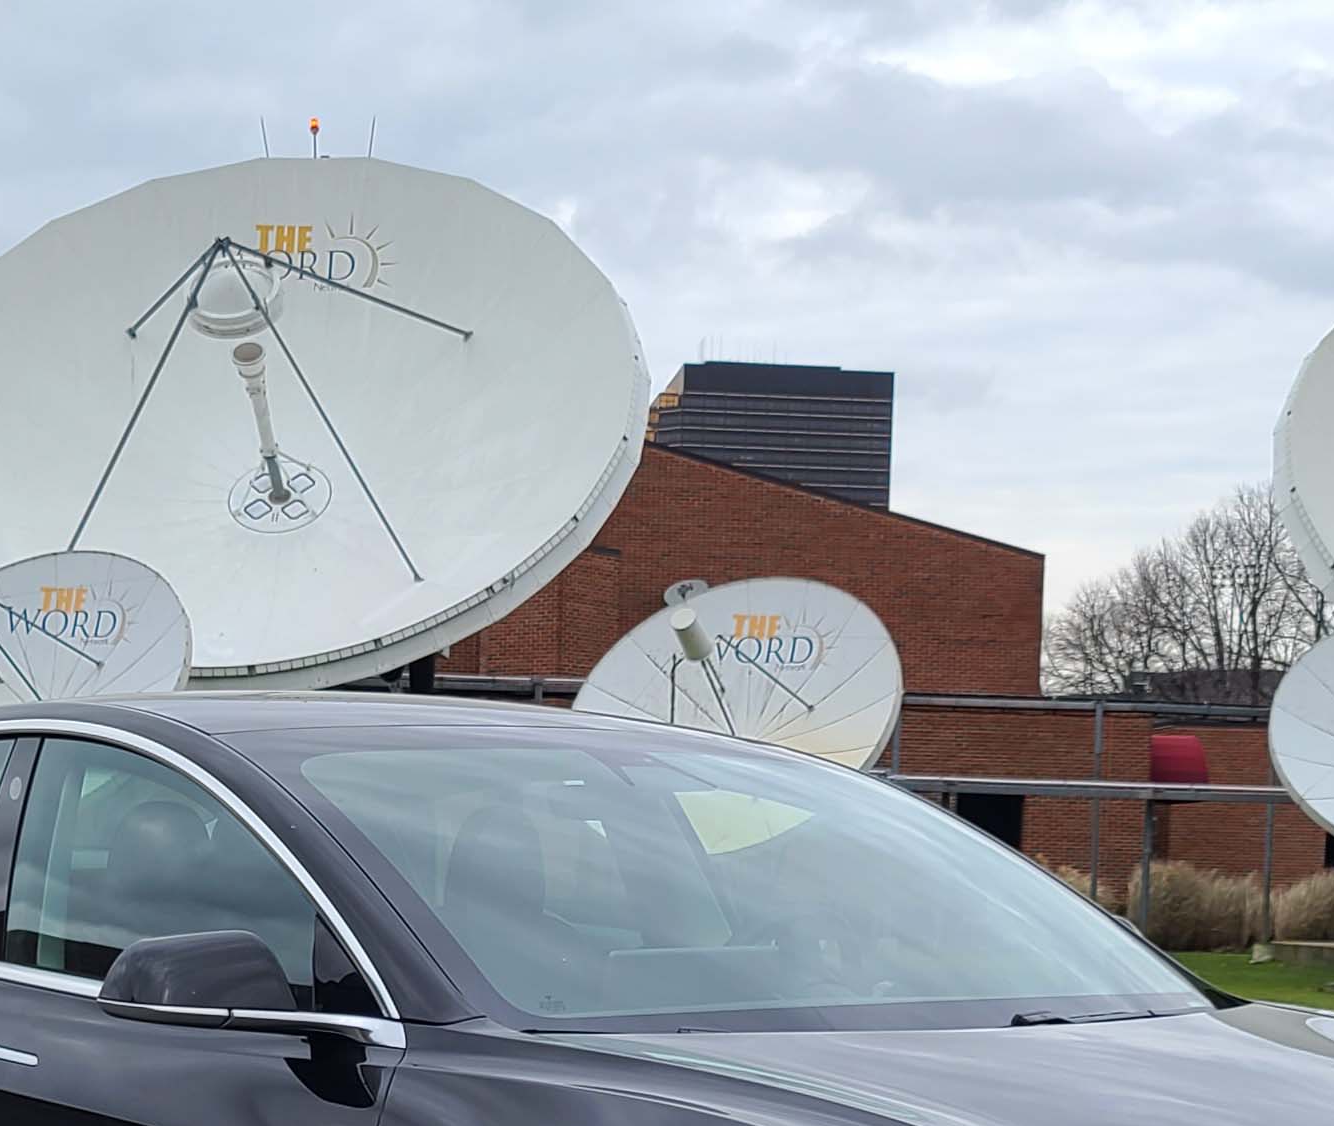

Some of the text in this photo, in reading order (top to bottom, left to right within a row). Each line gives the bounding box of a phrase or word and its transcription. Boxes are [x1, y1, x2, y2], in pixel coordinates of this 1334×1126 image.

[256, 225, 313, 253] THE
[267, 249, 355, 281] ORD
[40, 586, 88, 613] THE
[7, 607, 117, 639] WORD
[733, 614, 780, 639] THE
